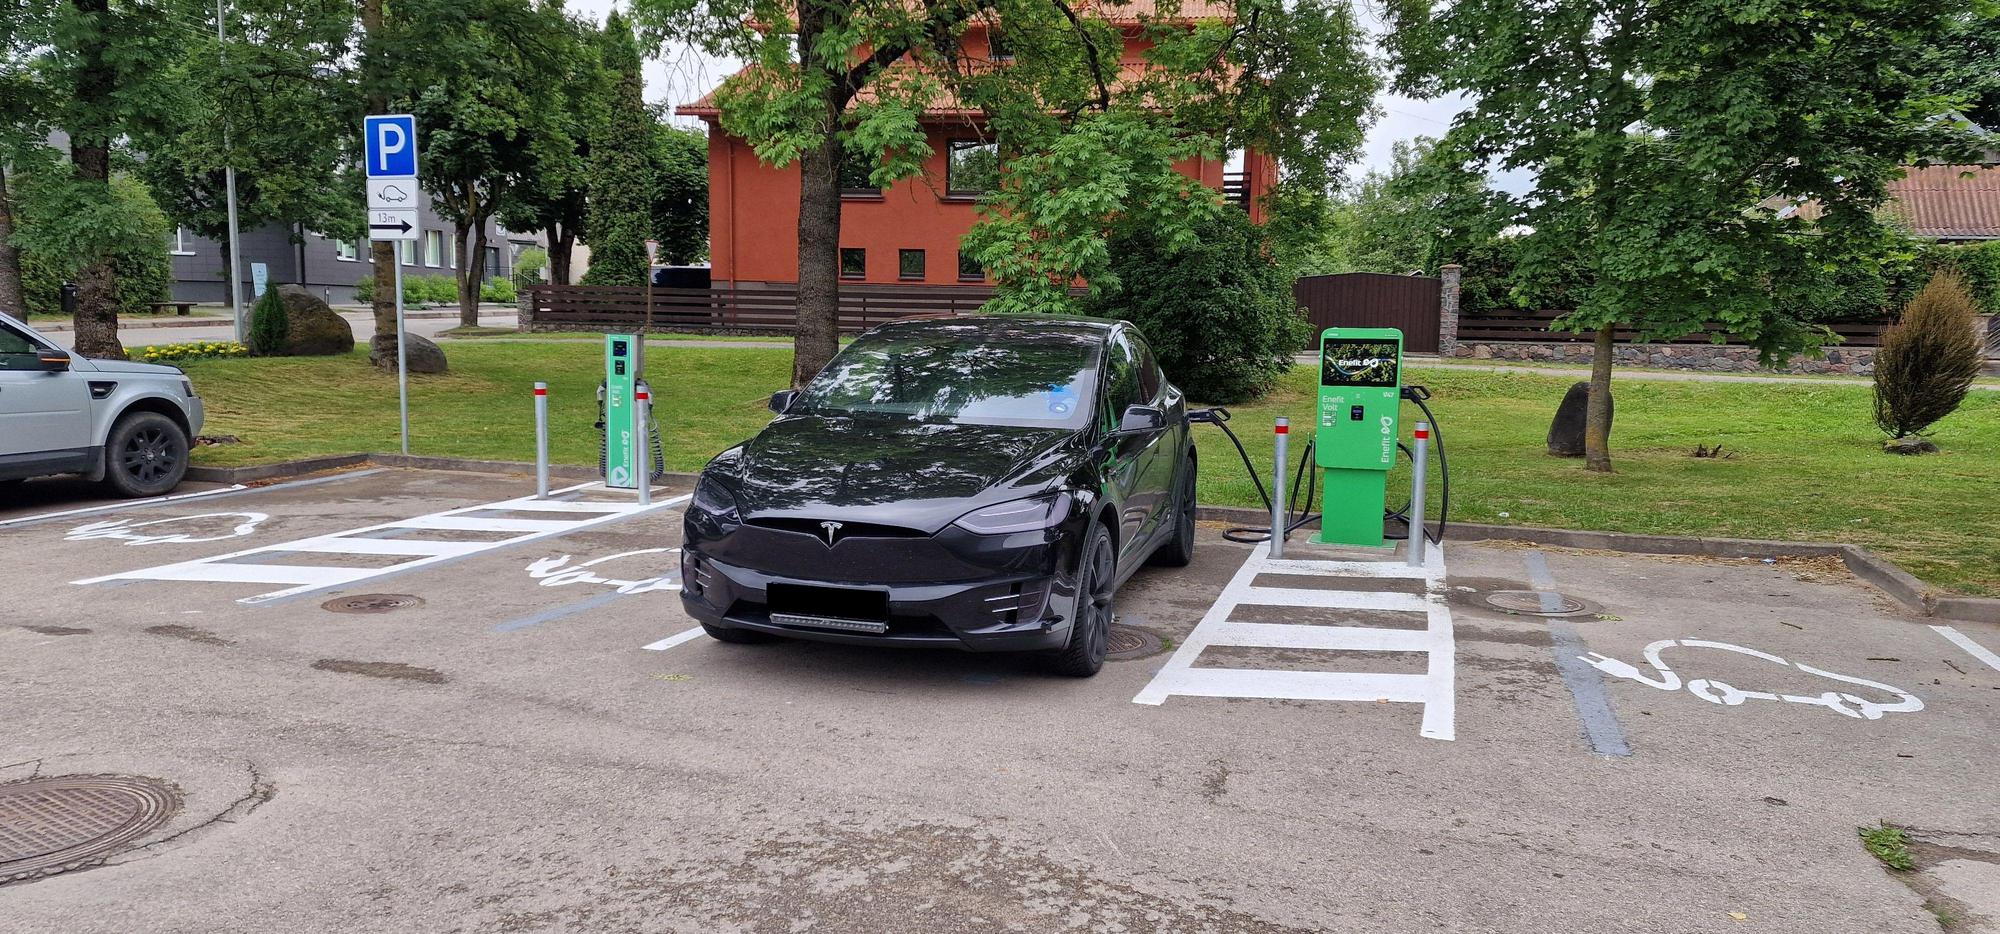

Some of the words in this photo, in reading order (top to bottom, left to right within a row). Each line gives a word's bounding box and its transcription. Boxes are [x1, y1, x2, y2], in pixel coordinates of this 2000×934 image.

[378, 123, 405, 171] P
[378, 213, 396, 223] 13m
[1322, 395, 1345, 403] Enefit
[1322, 403, 1338, 411] Volt
[1381, 436, 1391, 463] Enefit
